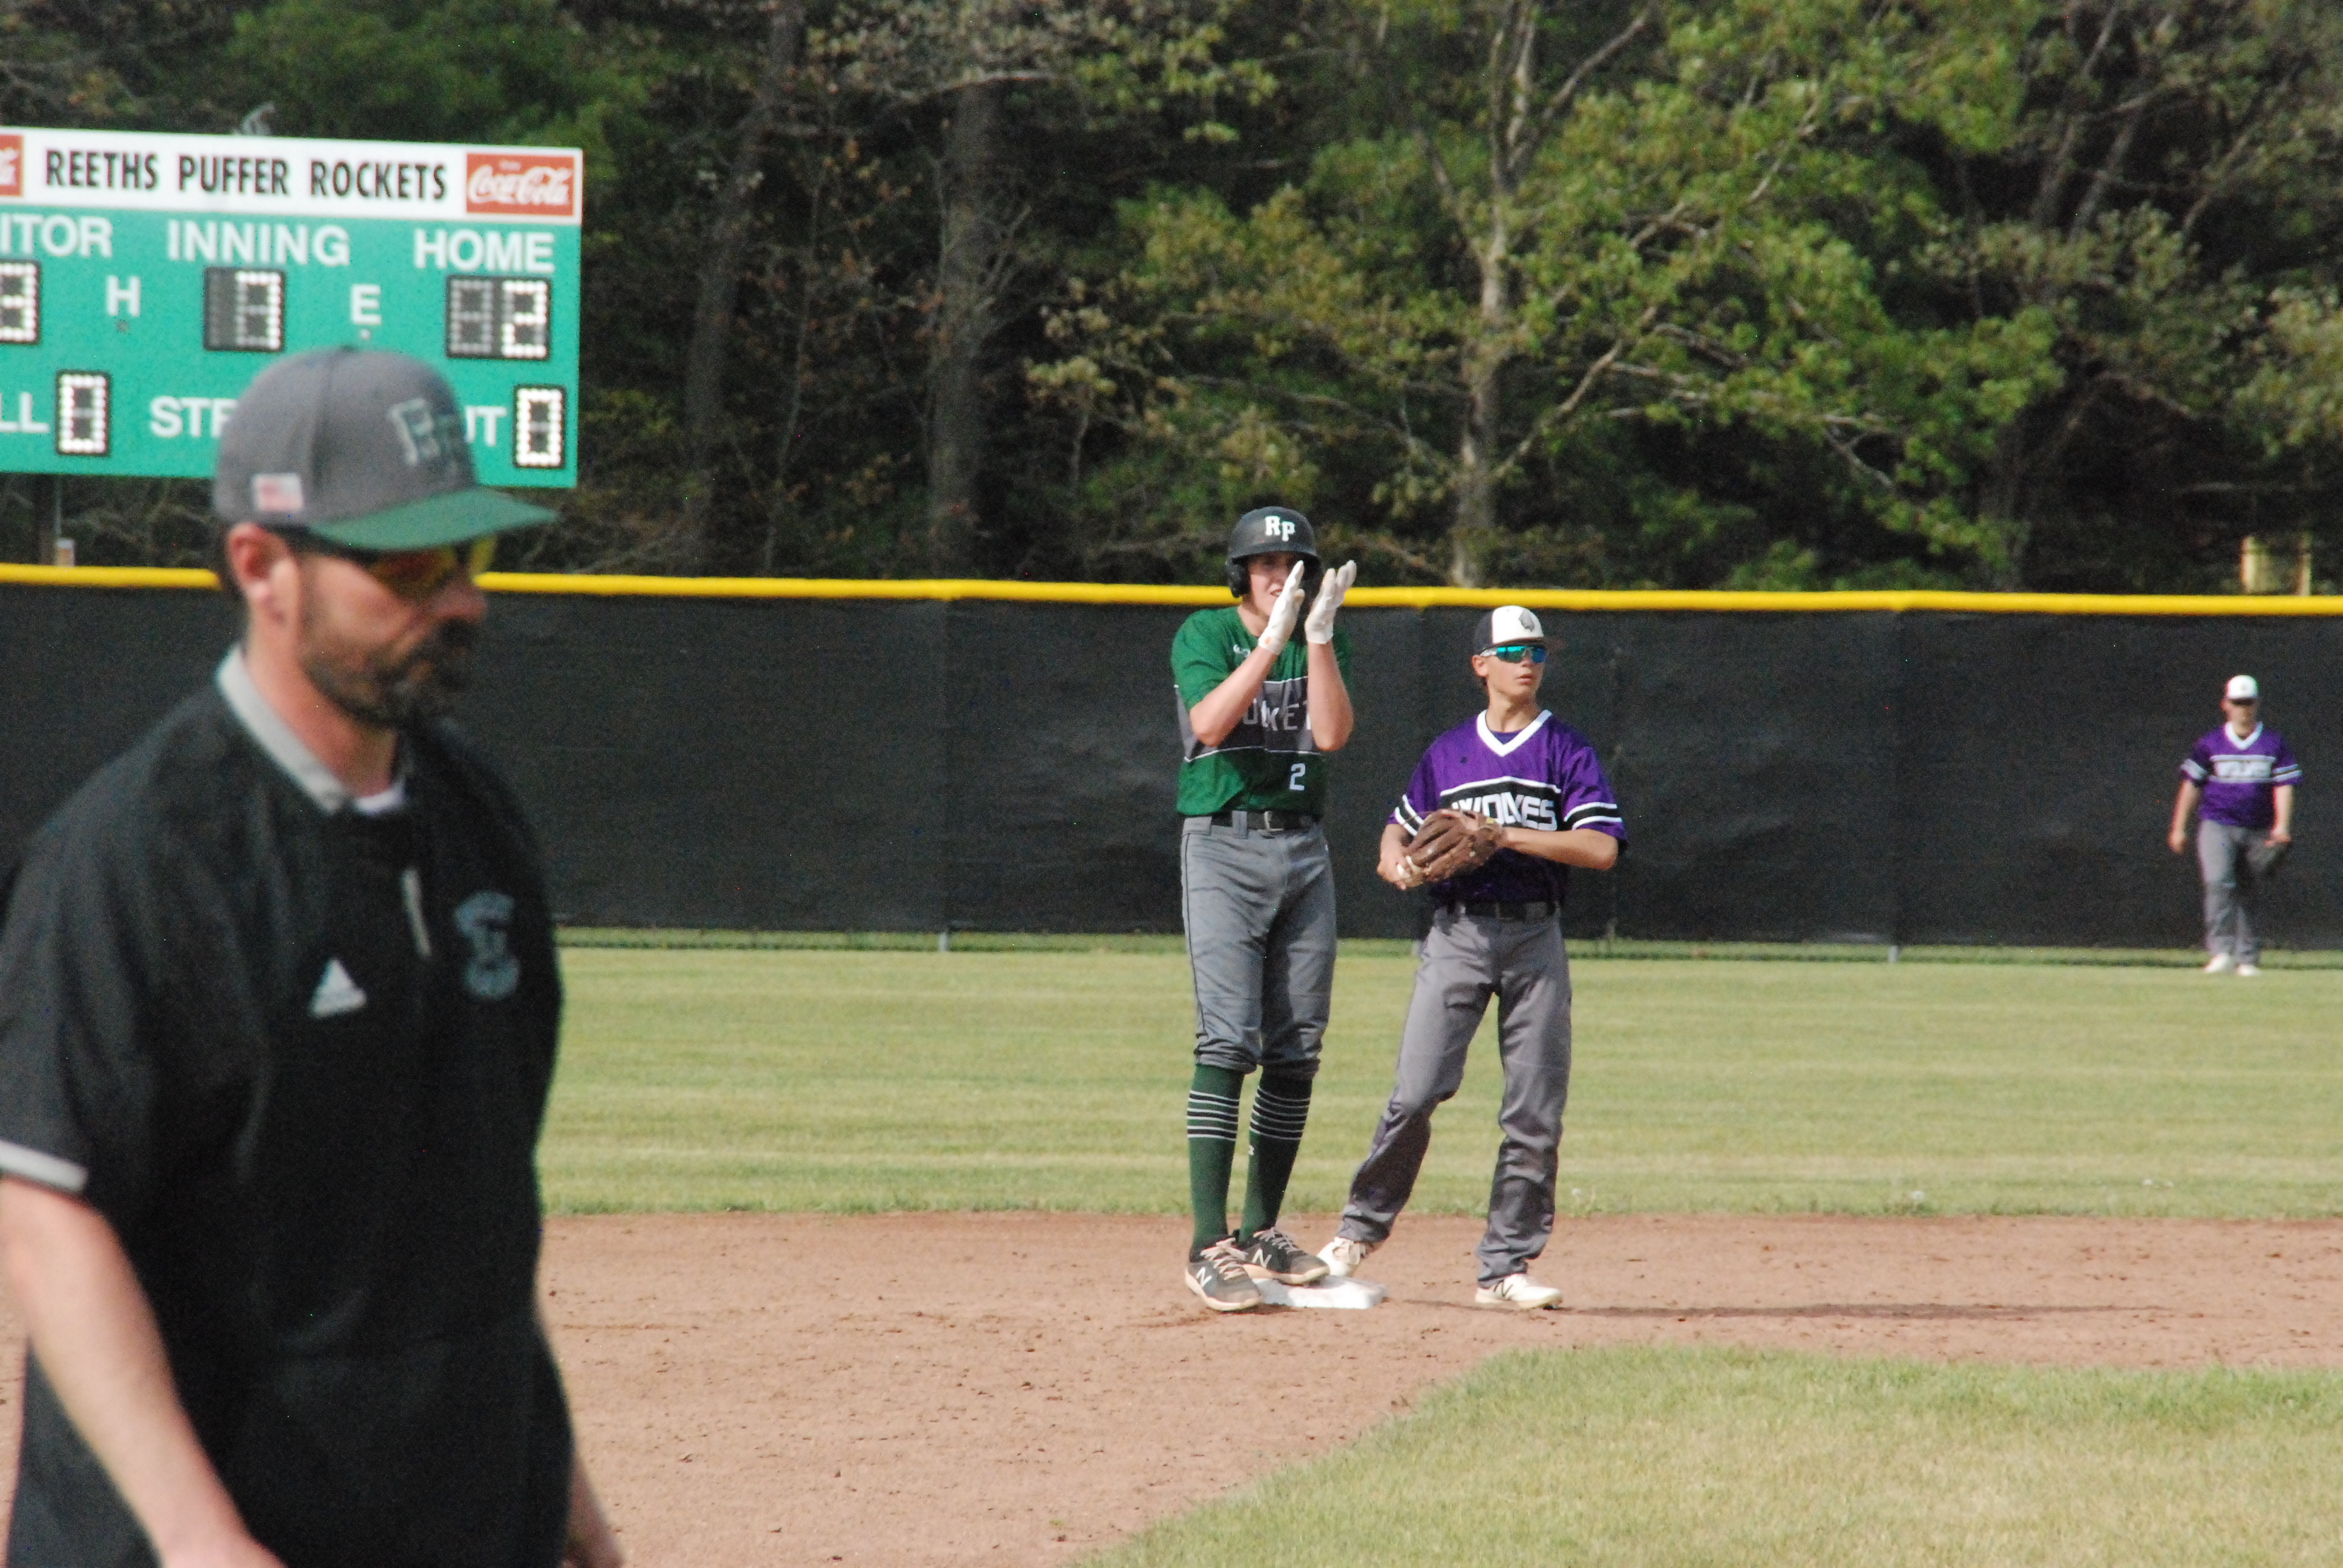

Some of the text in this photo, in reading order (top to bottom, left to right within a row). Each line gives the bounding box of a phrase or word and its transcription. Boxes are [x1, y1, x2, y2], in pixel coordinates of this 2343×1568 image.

[46, 149, 159, 191] REETHS
[178, 154, 290, 195] PUFFER
[310, 160, 447, 201] ROCKETS
[167, 219, 350, 267] INNING
[414, 229, 555, 273] HOME
[106, 275, 141, 317] H
[350, 284, 382, 325] E
[60, 374, 105, 453] 0
[516, 388, 563, 466] 0
[1289, 763, 1306, 791] 2
